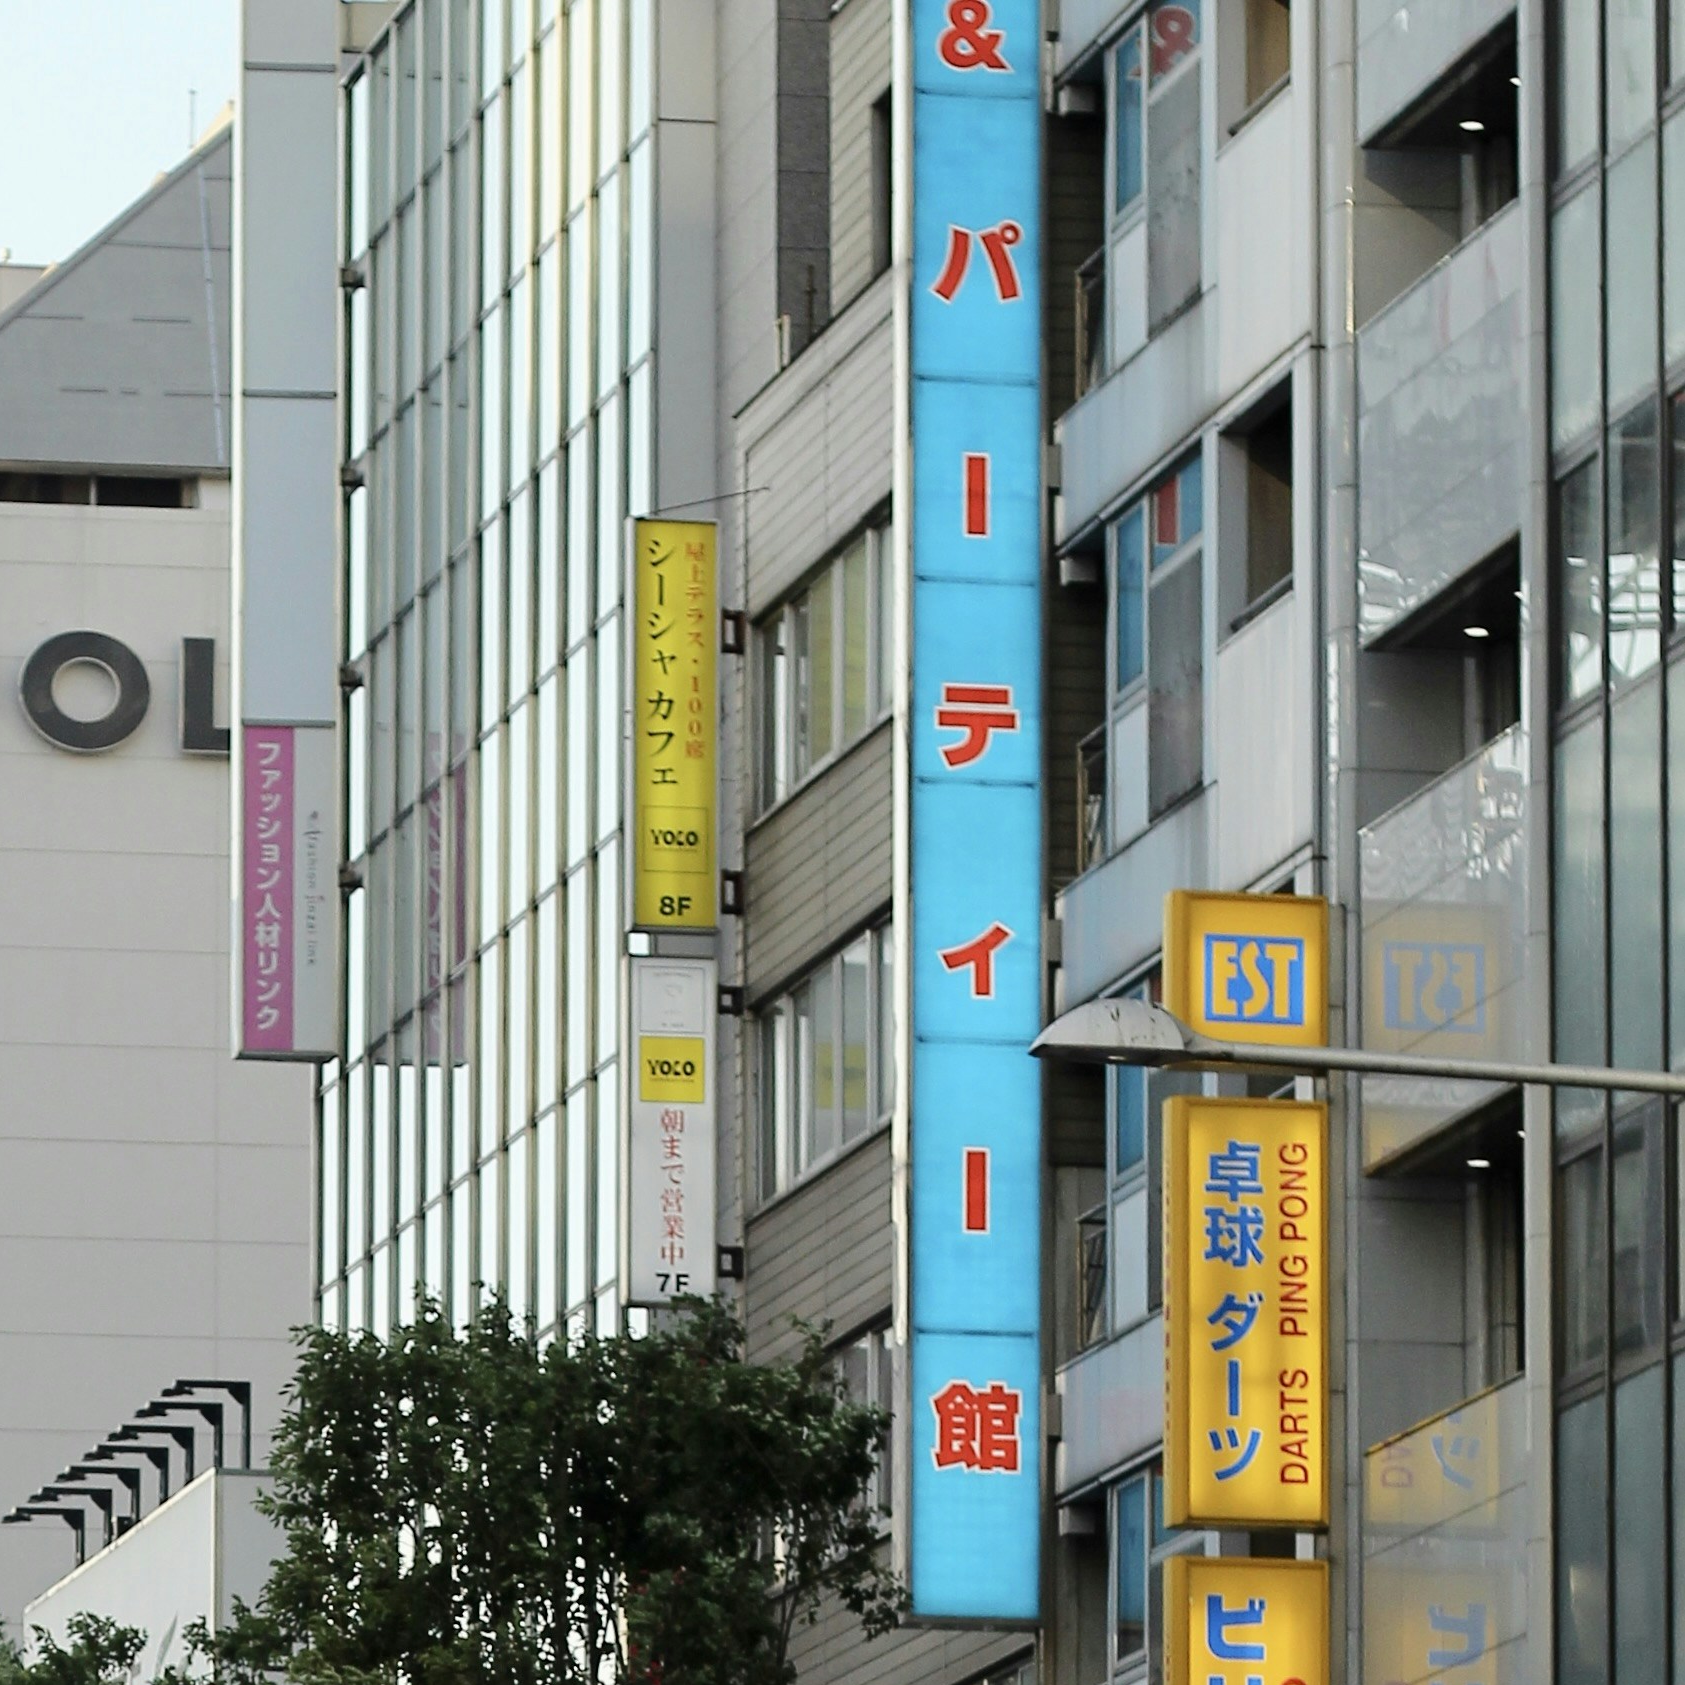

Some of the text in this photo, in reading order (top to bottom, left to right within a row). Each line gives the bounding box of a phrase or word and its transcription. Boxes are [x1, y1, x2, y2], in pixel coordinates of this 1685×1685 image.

[254, 741, 281, 1031] ファッション人材リンク
[659, 895, 693, 917] 8F
[1208, 937, 1302, 1021] EST
[660, 1109, 686, 1267] 朝まで営業中
[656, 1273, 690, 1294] 7F
[1278, 1140, 1310, 1486] DARTS PING PONG
